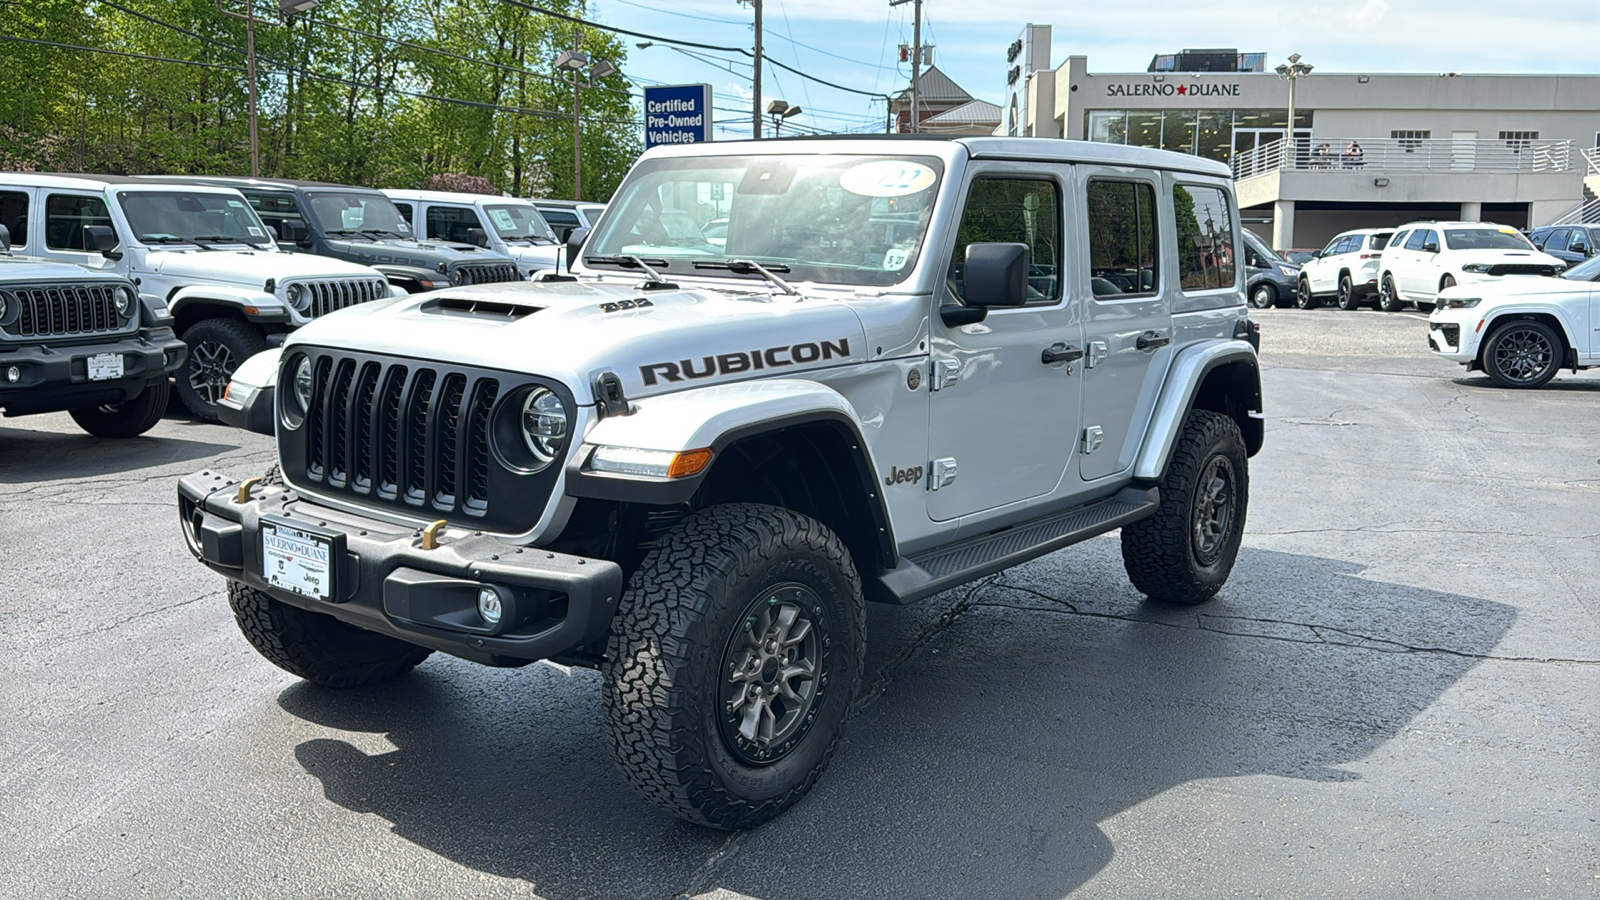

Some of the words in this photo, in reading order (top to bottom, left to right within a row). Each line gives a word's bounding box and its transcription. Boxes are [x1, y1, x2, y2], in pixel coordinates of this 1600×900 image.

[1106, 83, 1175, 97] SALERNO
[1189, 83, 1240, 96] DUANE
[647, 98, 695, 113] Certified
[648, 113, 702, 128] Pre-Owned
[648, 130, 695, 144] Vehicles
[887, 255, 894, 264] 5
[639, 338, 851, 387] RUBICON
[885, 465, 923, 486] Jeep
[265, 535, 298, 553] SALERNO
[301, 545, 328, 562] DUANE
[303, 573, 320, 586] Jeep
